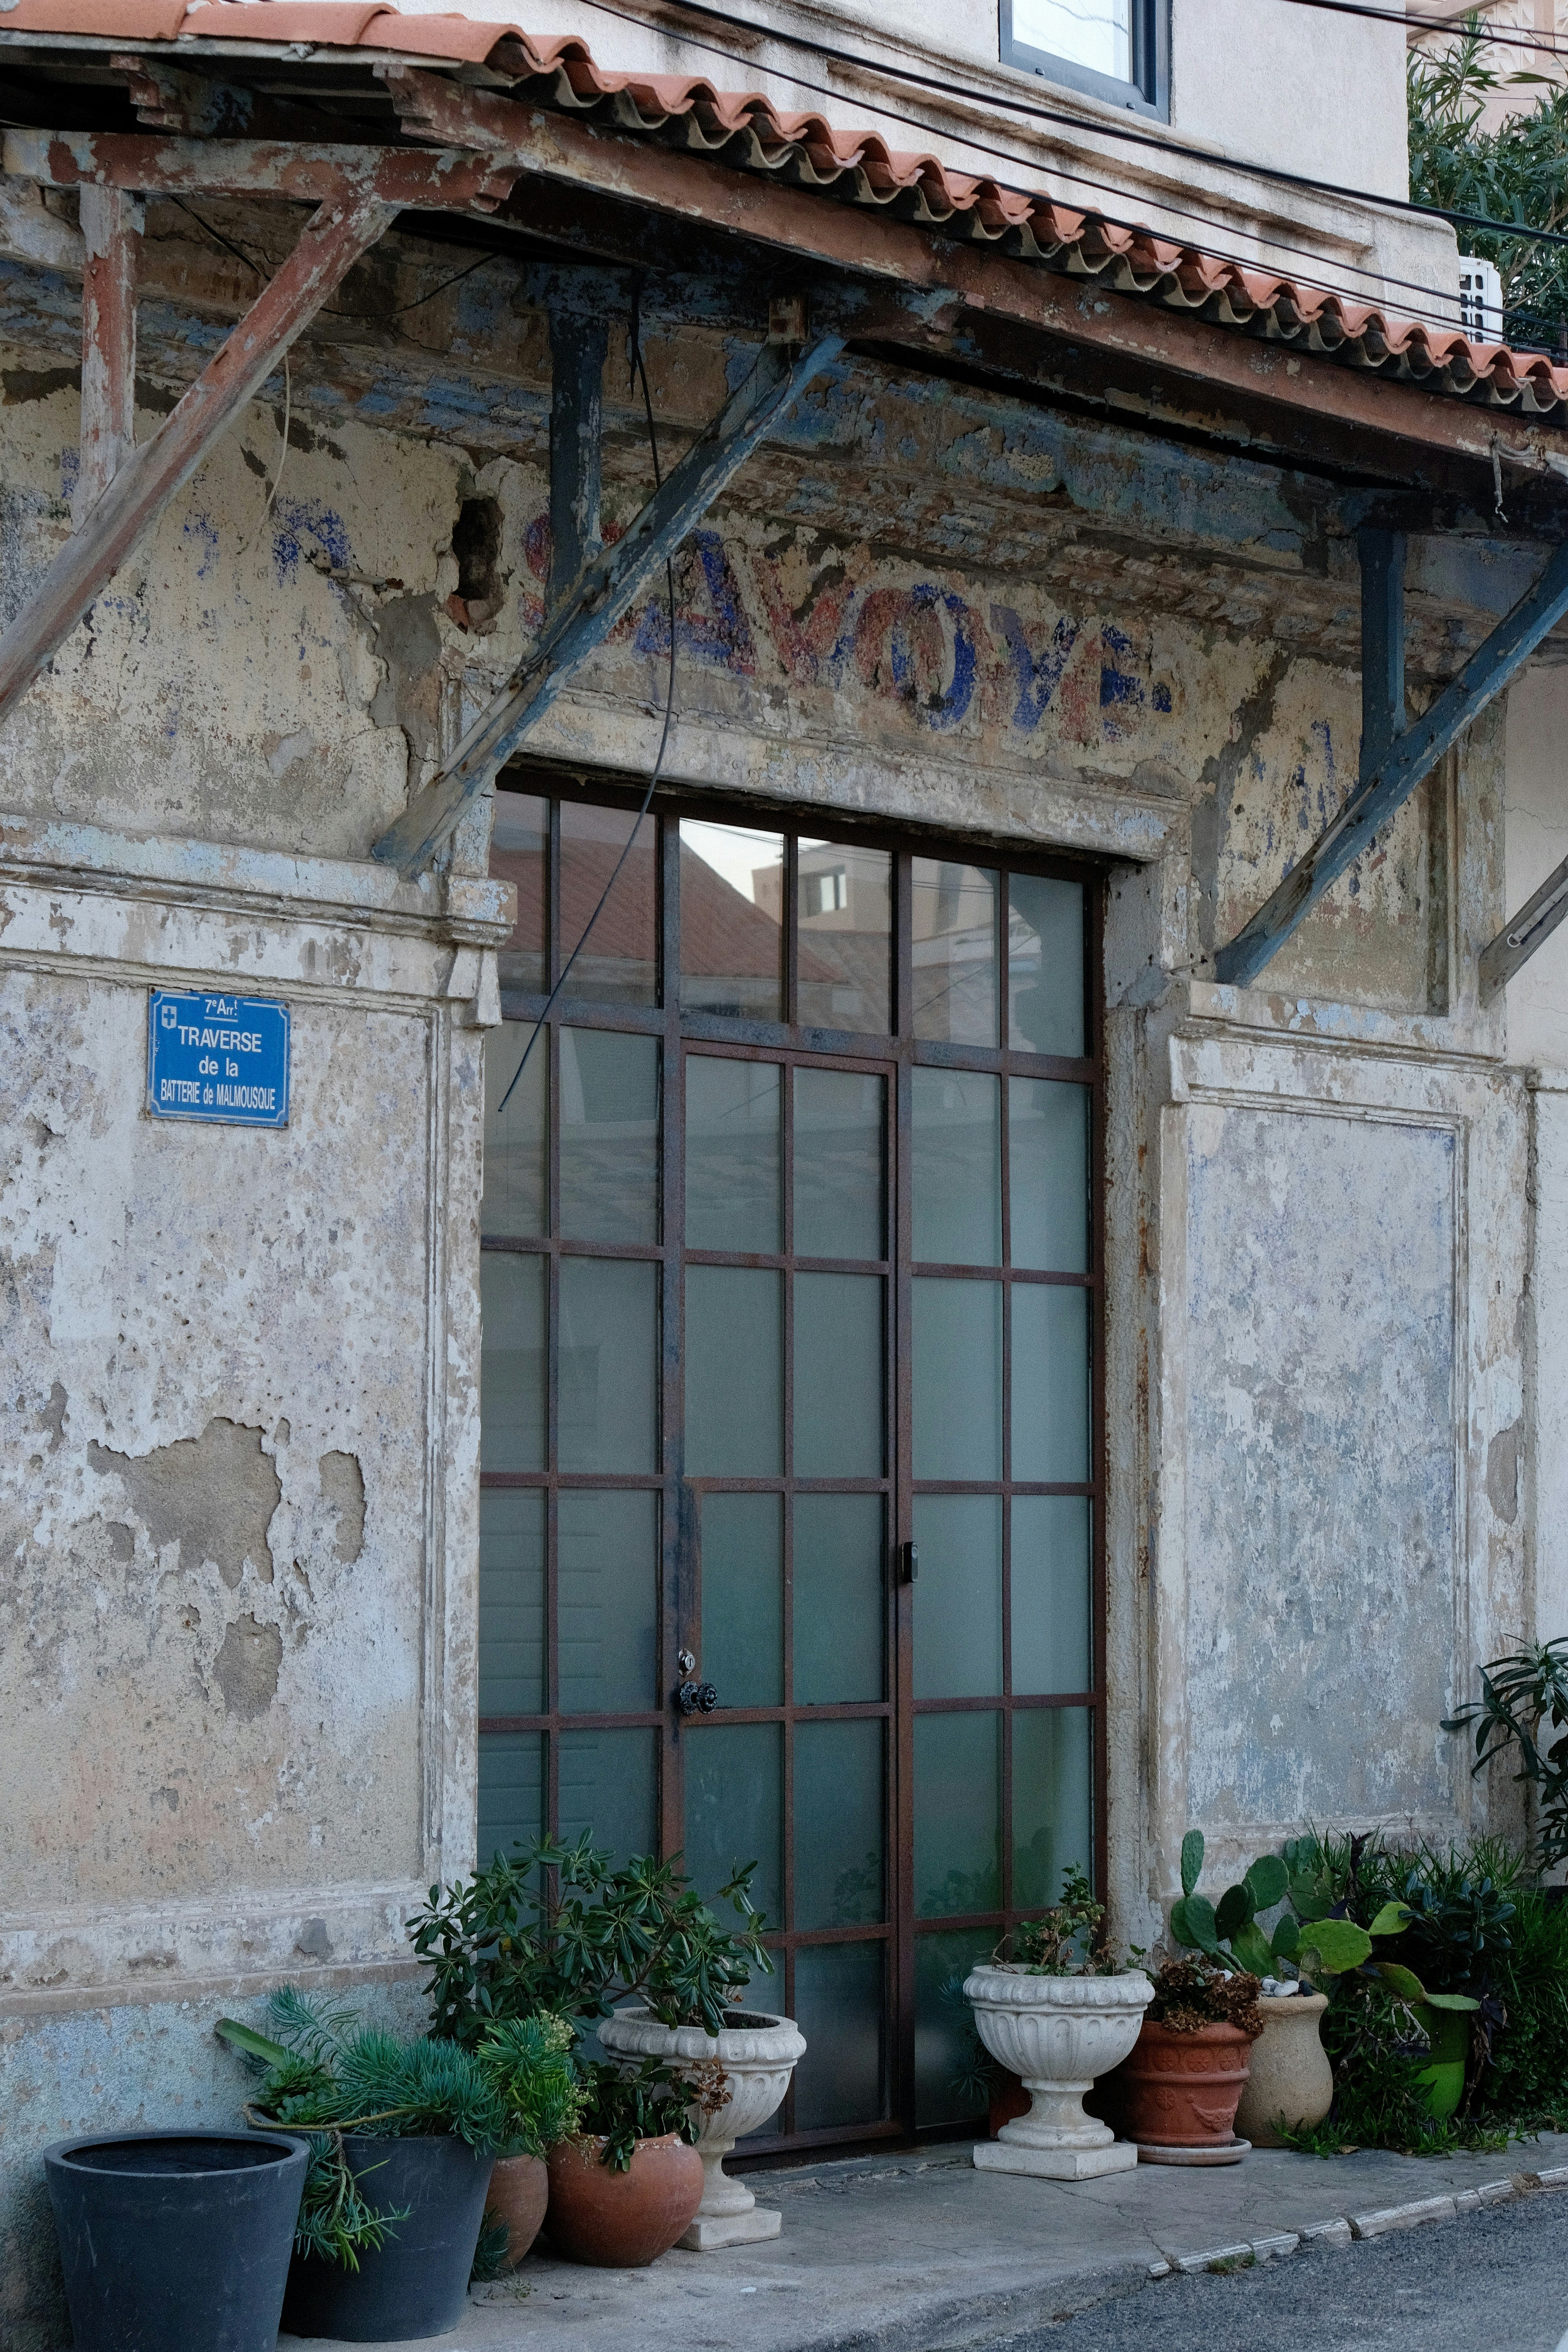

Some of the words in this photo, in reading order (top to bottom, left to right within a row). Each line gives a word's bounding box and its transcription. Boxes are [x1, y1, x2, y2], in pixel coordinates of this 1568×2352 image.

[178, 1025, 262, 1053] TRAVERSE
[199, 1056, 218, 1075] de
[226, 1058, 238, 1076] la
[161, 1079, 200, 1103] BATTERIE
[203, 1083, 213, 1105] de
[216, 1083, 275, 1110] MALMOUSQUE
